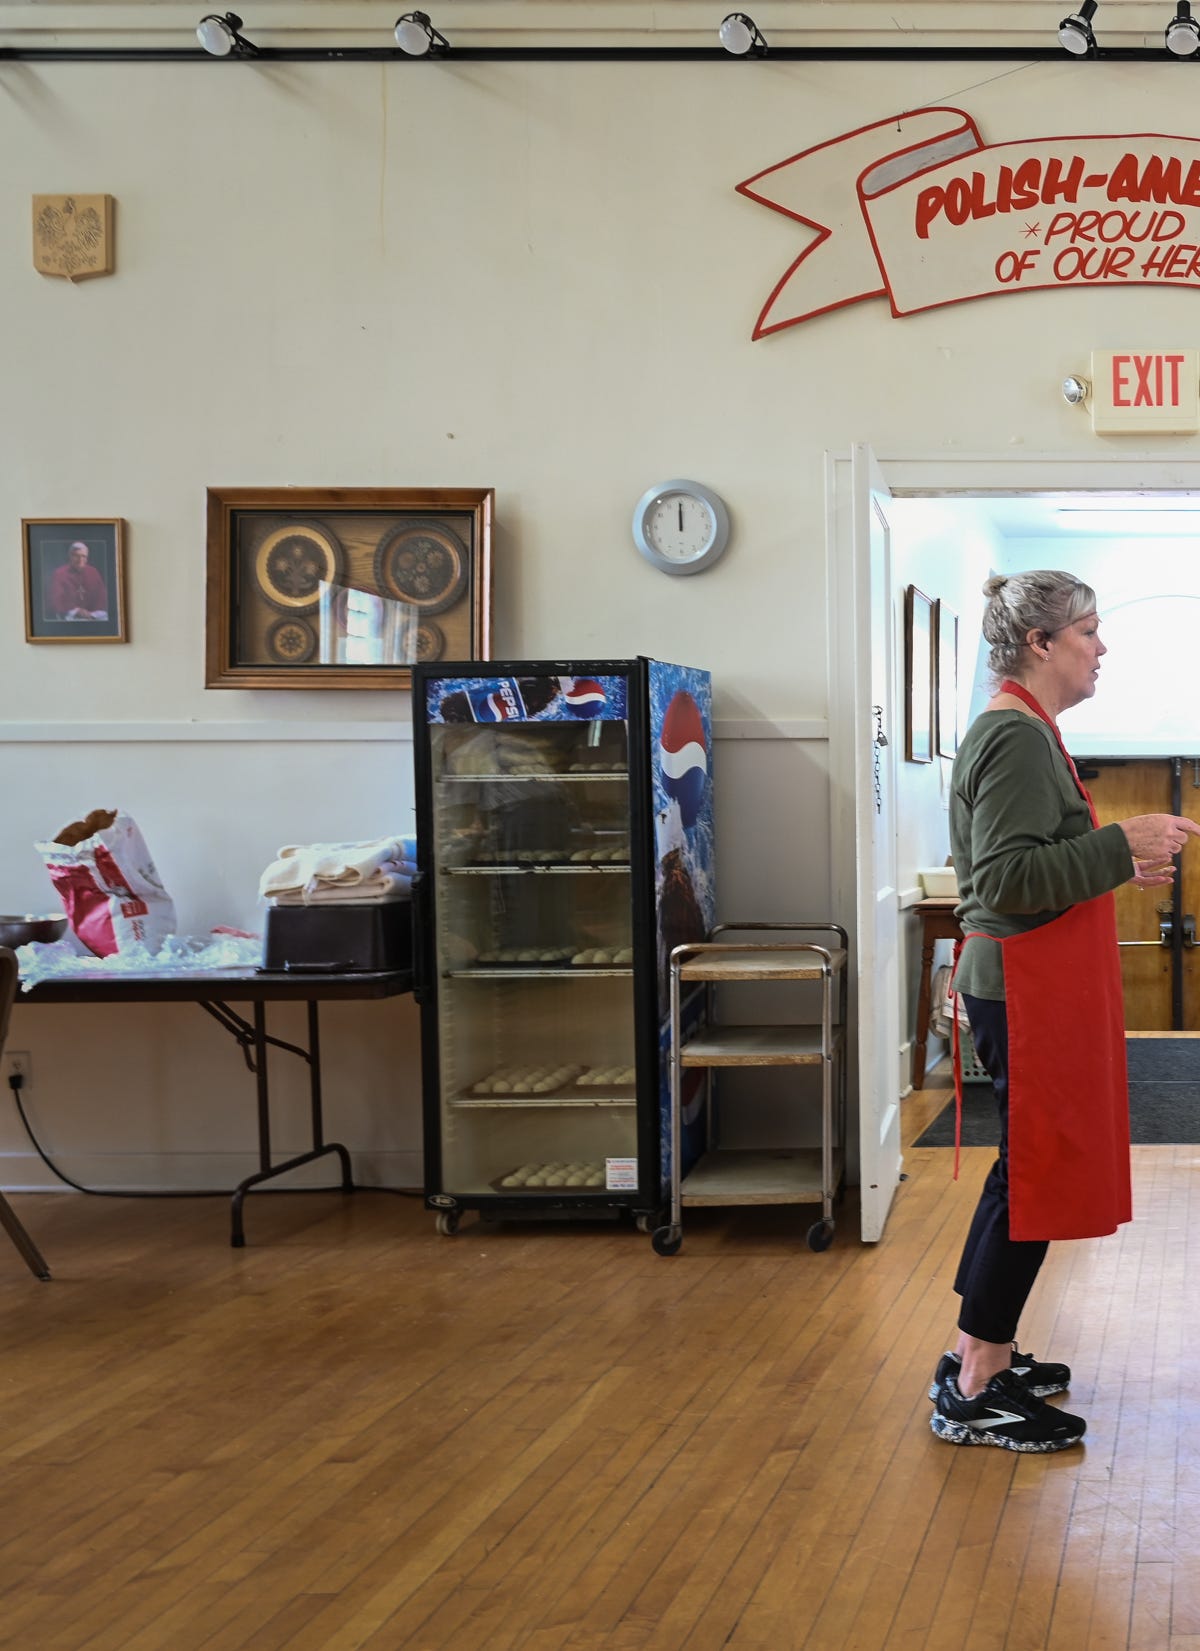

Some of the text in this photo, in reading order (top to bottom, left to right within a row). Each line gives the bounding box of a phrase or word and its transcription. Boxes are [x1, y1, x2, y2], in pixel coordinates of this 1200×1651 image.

[1044, 210, 1186, 246] PROUD
[994, 249, 1041, 283] OF
[1053, 246, 1135, 282] OUR
[1111, 354, 1185, 408] EXIT
[497, 680, 520, 719] PEPSI
